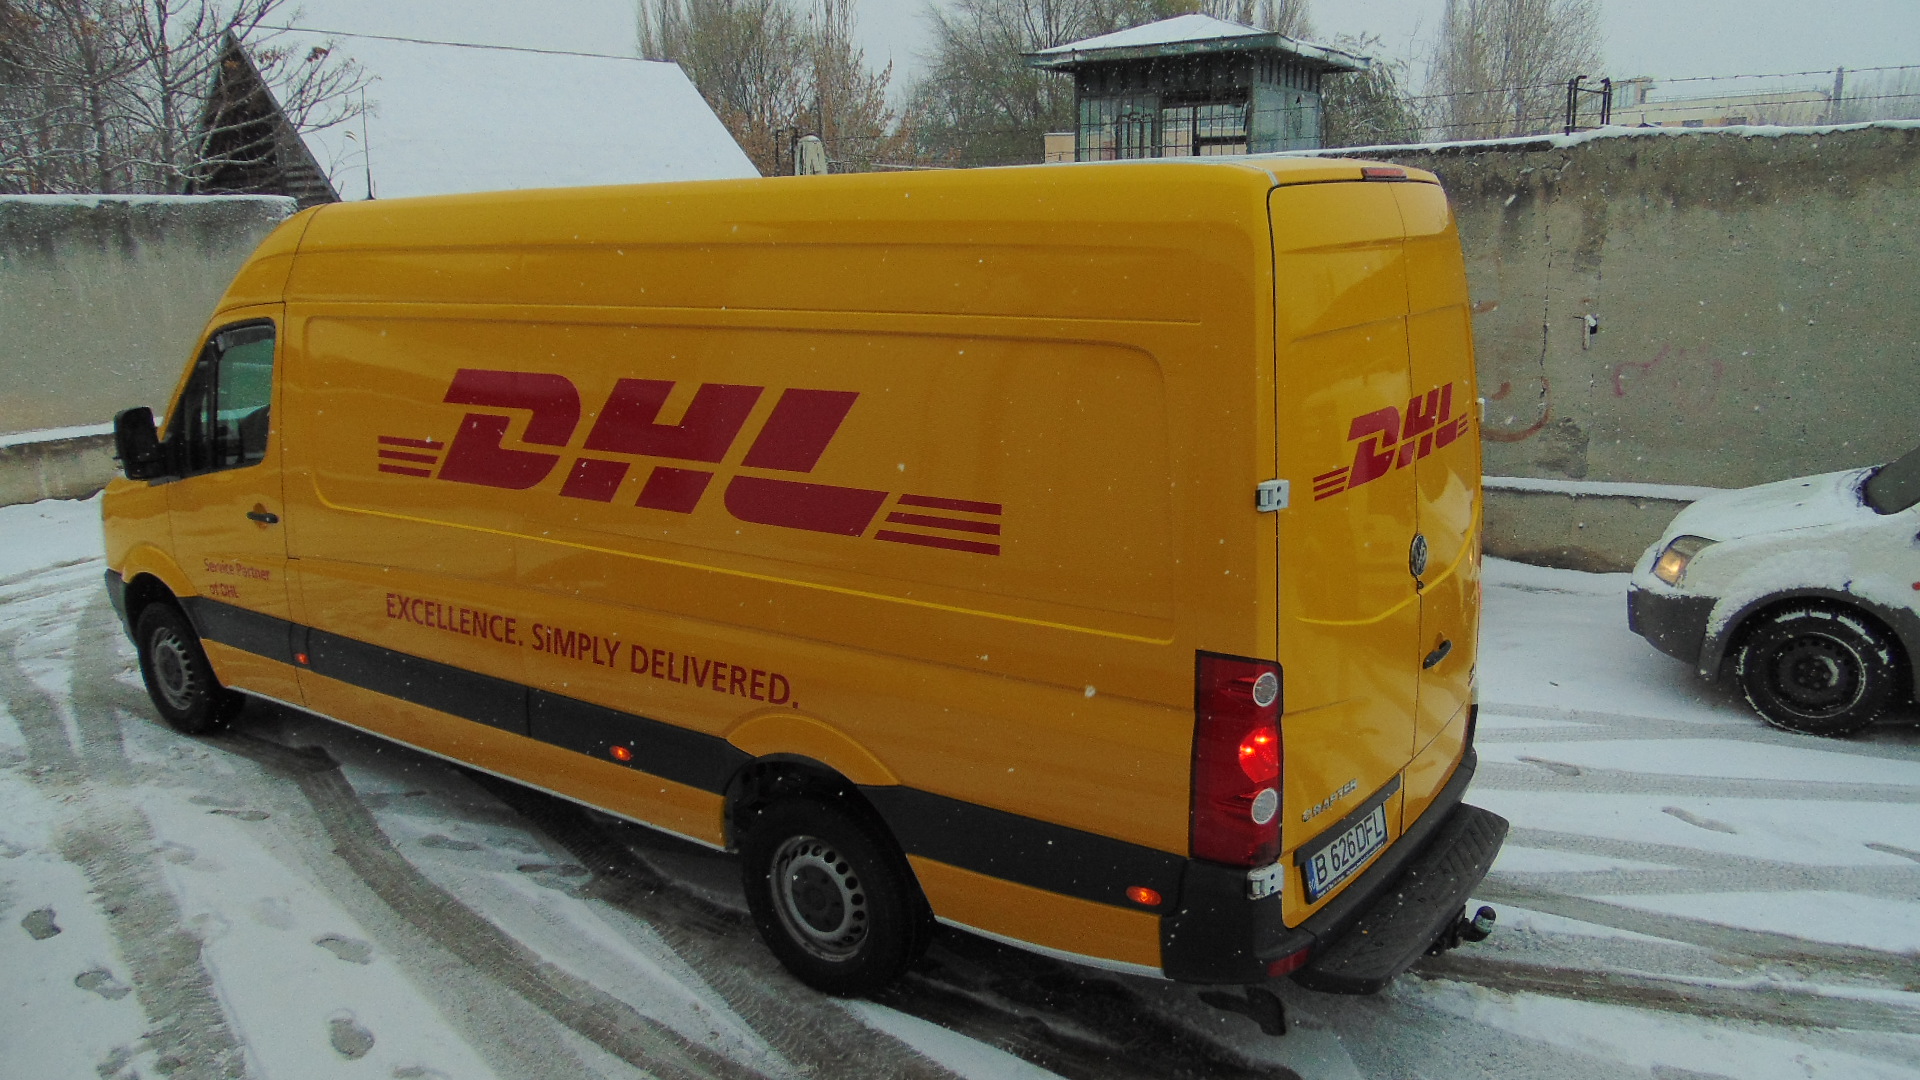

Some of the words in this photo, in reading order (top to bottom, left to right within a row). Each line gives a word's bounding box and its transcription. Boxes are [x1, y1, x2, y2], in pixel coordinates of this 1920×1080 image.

[436, 368, 890, 537] DHL
[1347, 382, 1459, 489] DHL
[204, 558, 234, 576] Service
[235, 563, 270, 580] Partner
[386, 592, 524, 647] EXCELLENCE.
[630, 644, 800, 709] DELIVERED.
[1302, 778, 1358, 823] CRAFTER
[1316, 854, 1328, 885] B
